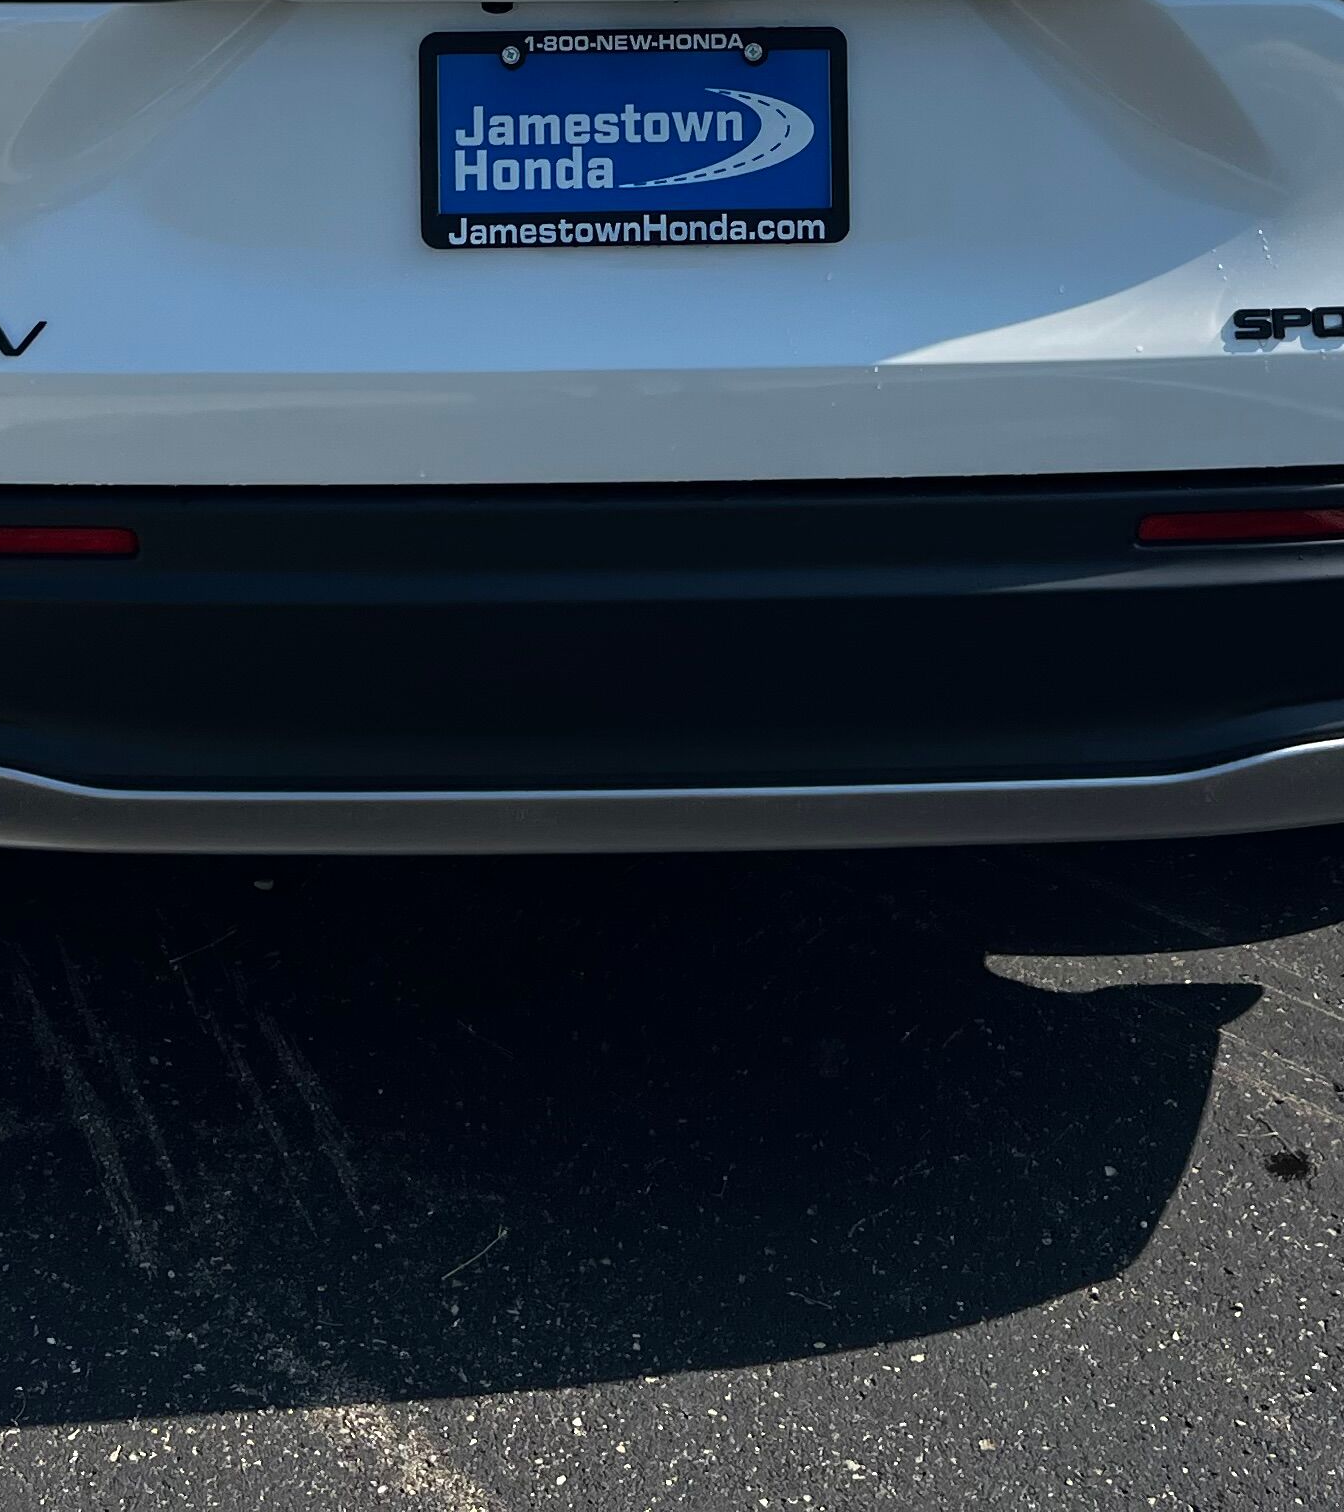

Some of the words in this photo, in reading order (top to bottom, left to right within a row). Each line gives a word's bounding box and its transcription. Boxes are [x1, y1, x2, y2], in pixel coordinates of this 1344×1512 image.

[523, 33, 744, 52] 1-800-NEW-HONDA
[455, 103, 744, 147] Jamestown
[454, 146, 614, 192] Honda
[448, 213, 826, 246] JamestownHonda.com
